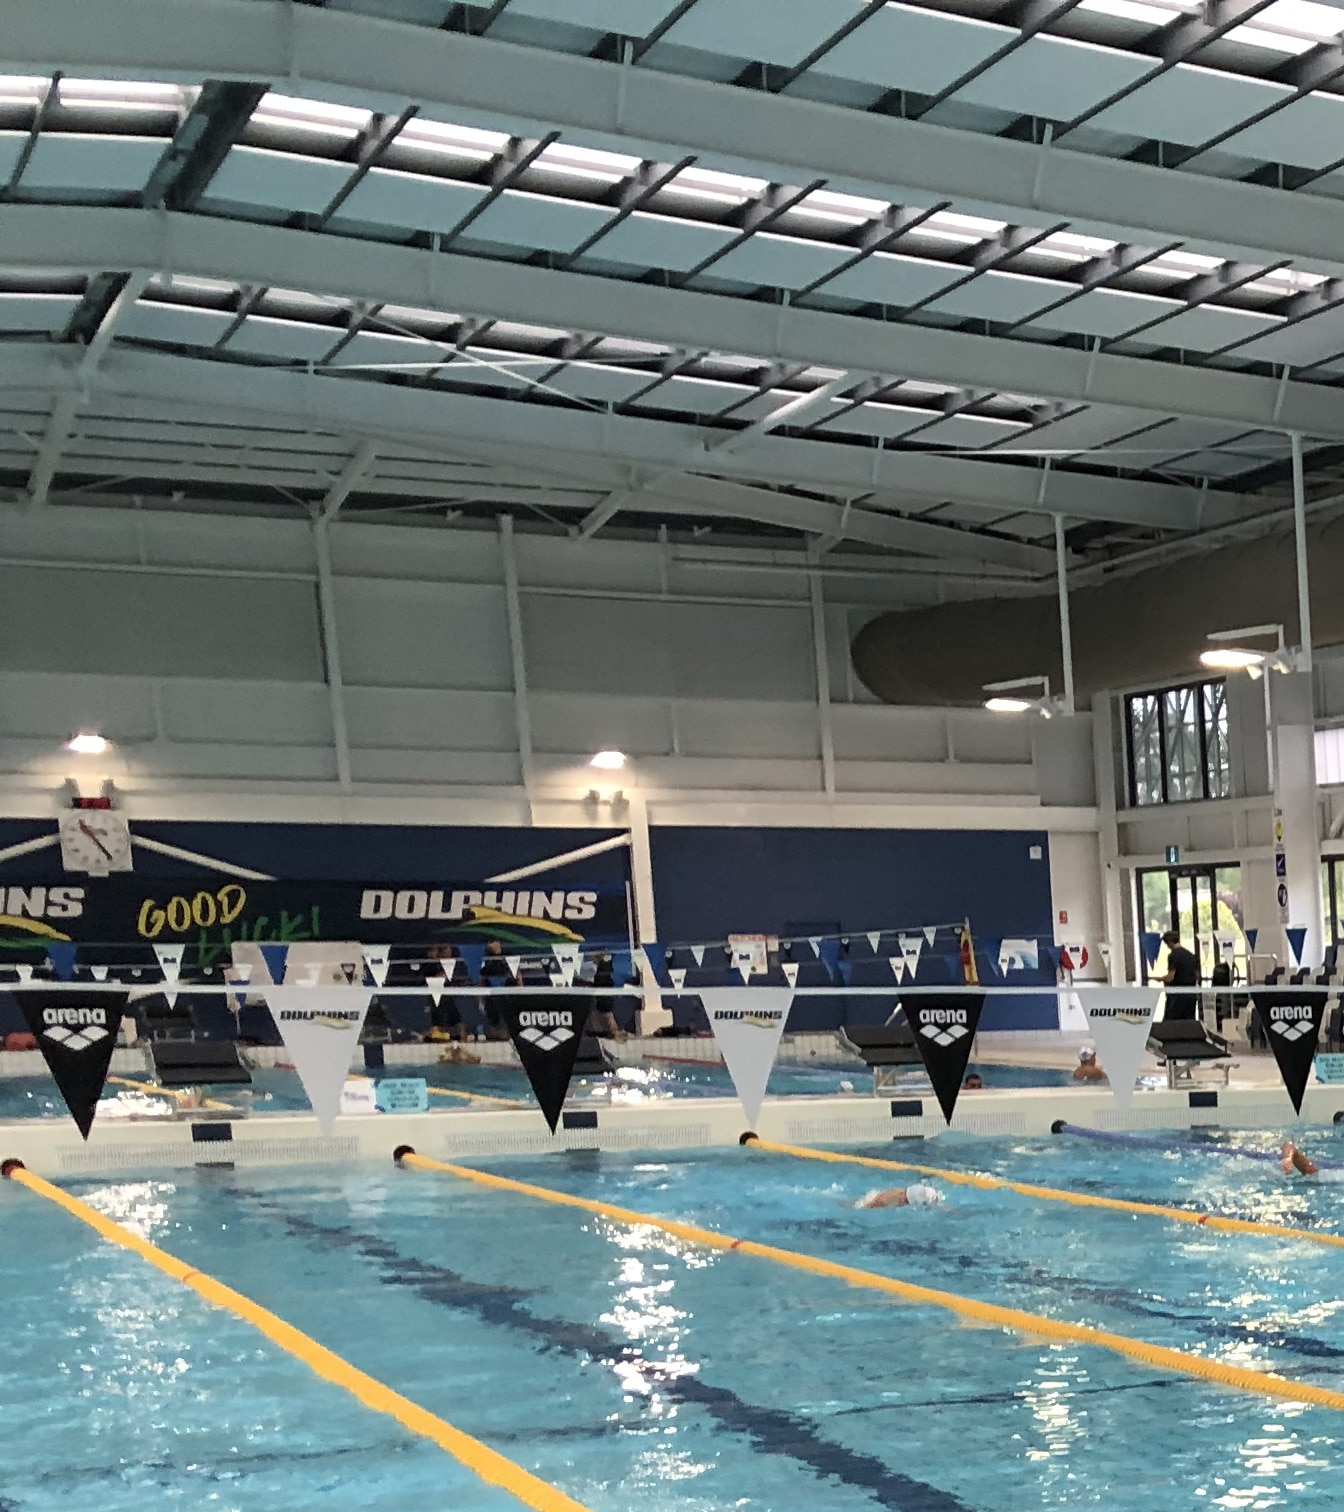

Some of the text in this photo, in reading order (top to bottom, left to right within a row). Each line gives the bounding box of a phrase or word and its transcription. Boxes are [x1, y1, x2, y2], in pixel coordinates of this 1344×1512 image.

[138, 884, 246, 937] GOOD
[360, 889, 597, 920] DOLPHINS
[42, 1007, 107, 1026] arena
[280, 1010, 360, 1021] DOLPHINS
[519, 1010, 573, 1027] arena
[714, 1010, 783, 1021] DOLPHINS
[919, 1008, 967, 1024] arena
[1089, 1007, 1152, 1018] DOLPHINS
[1270, 1005, 1312, 1020] arena
